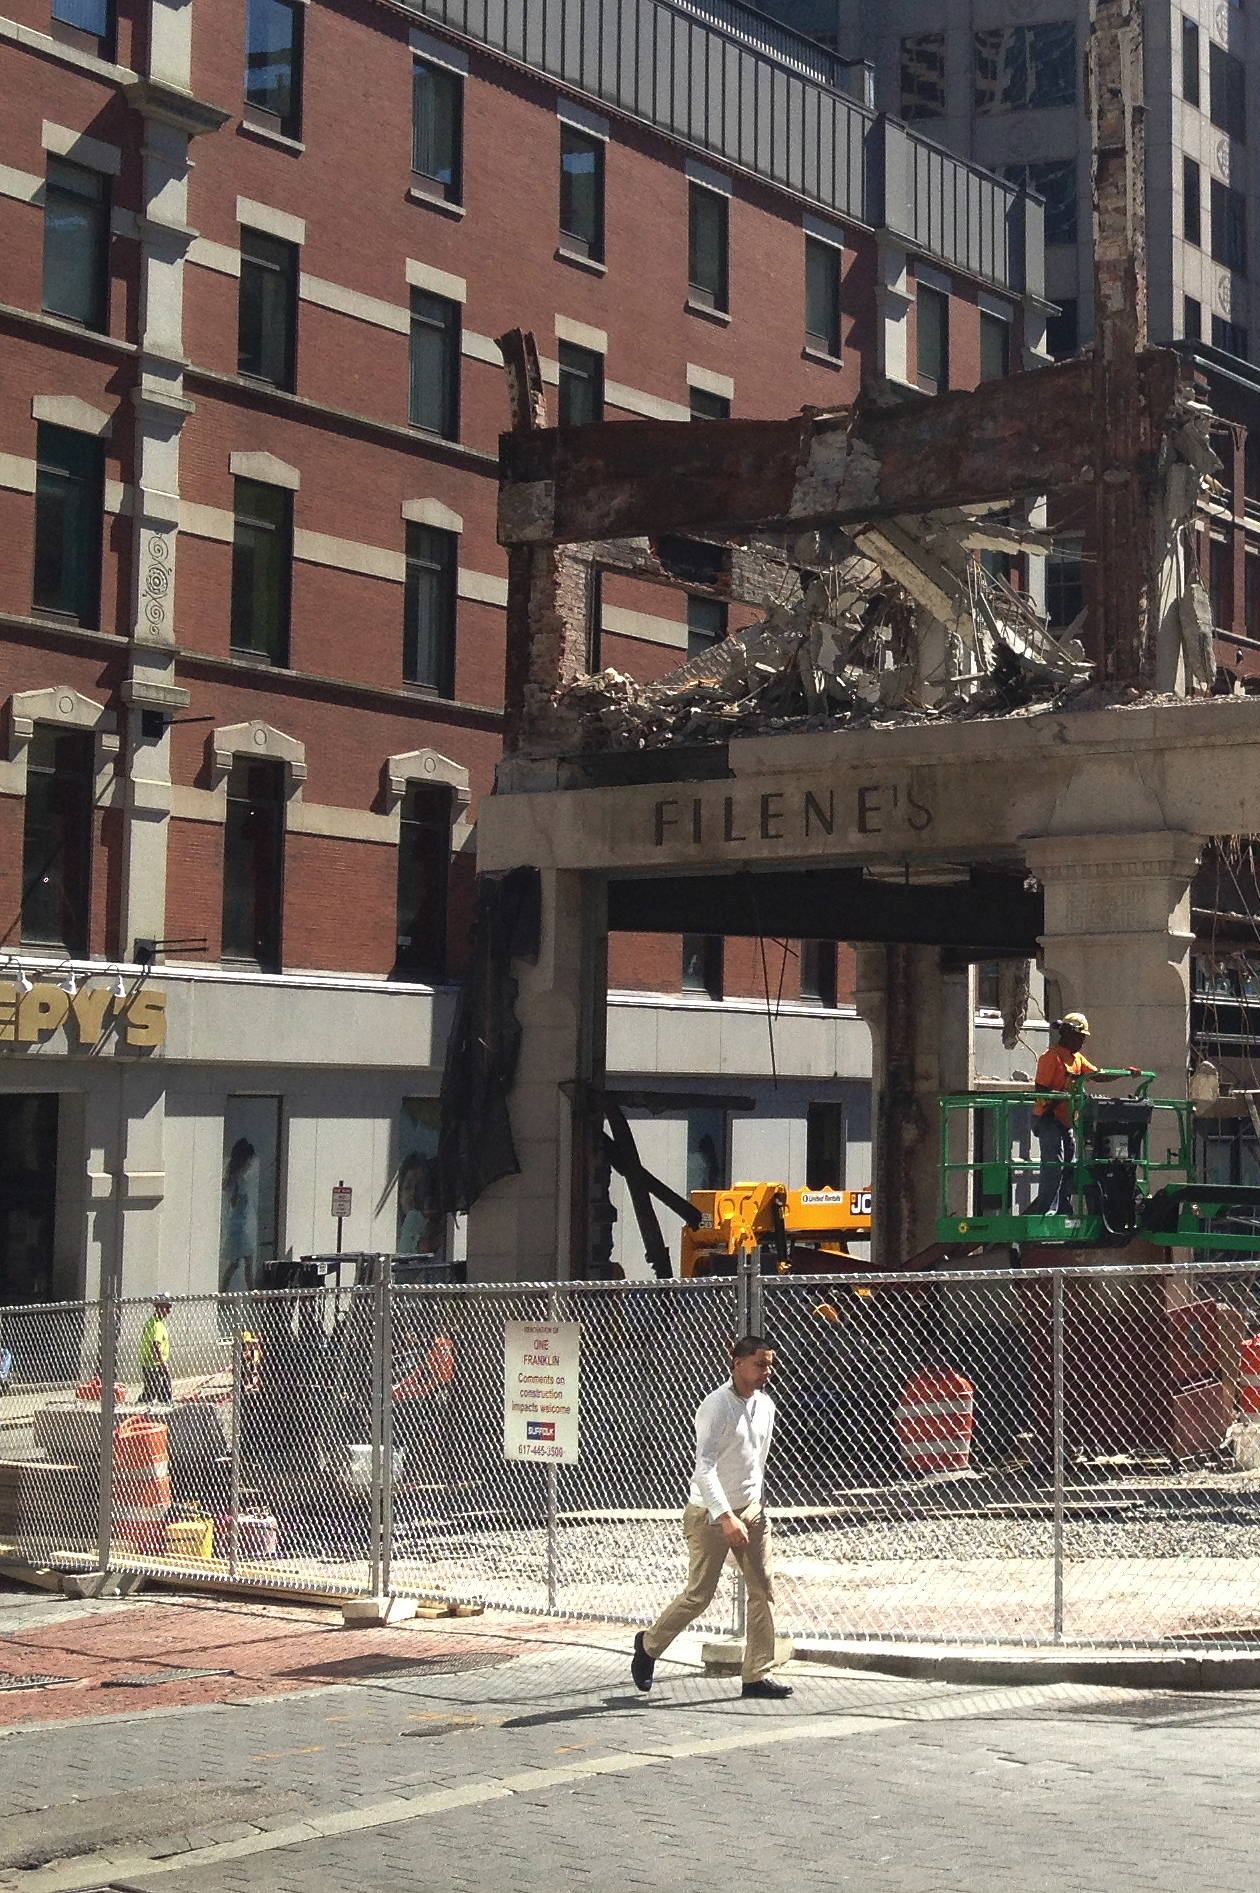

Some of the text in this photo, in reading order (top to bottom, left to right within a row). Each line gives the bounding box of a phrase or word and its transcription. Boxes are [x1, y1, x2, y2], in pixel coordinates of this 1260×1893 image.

[654, 784, 933, 847] FILENE'S
[533, 1339, 549, 1350] ONE
[523, 1354, 560, 1366] FRANKLIN
[518, 1372, 566, 1385] Comments on
[520, 1389, 563, 1399] construction
[527, 1426, 554, 1436] SUFFOLK
